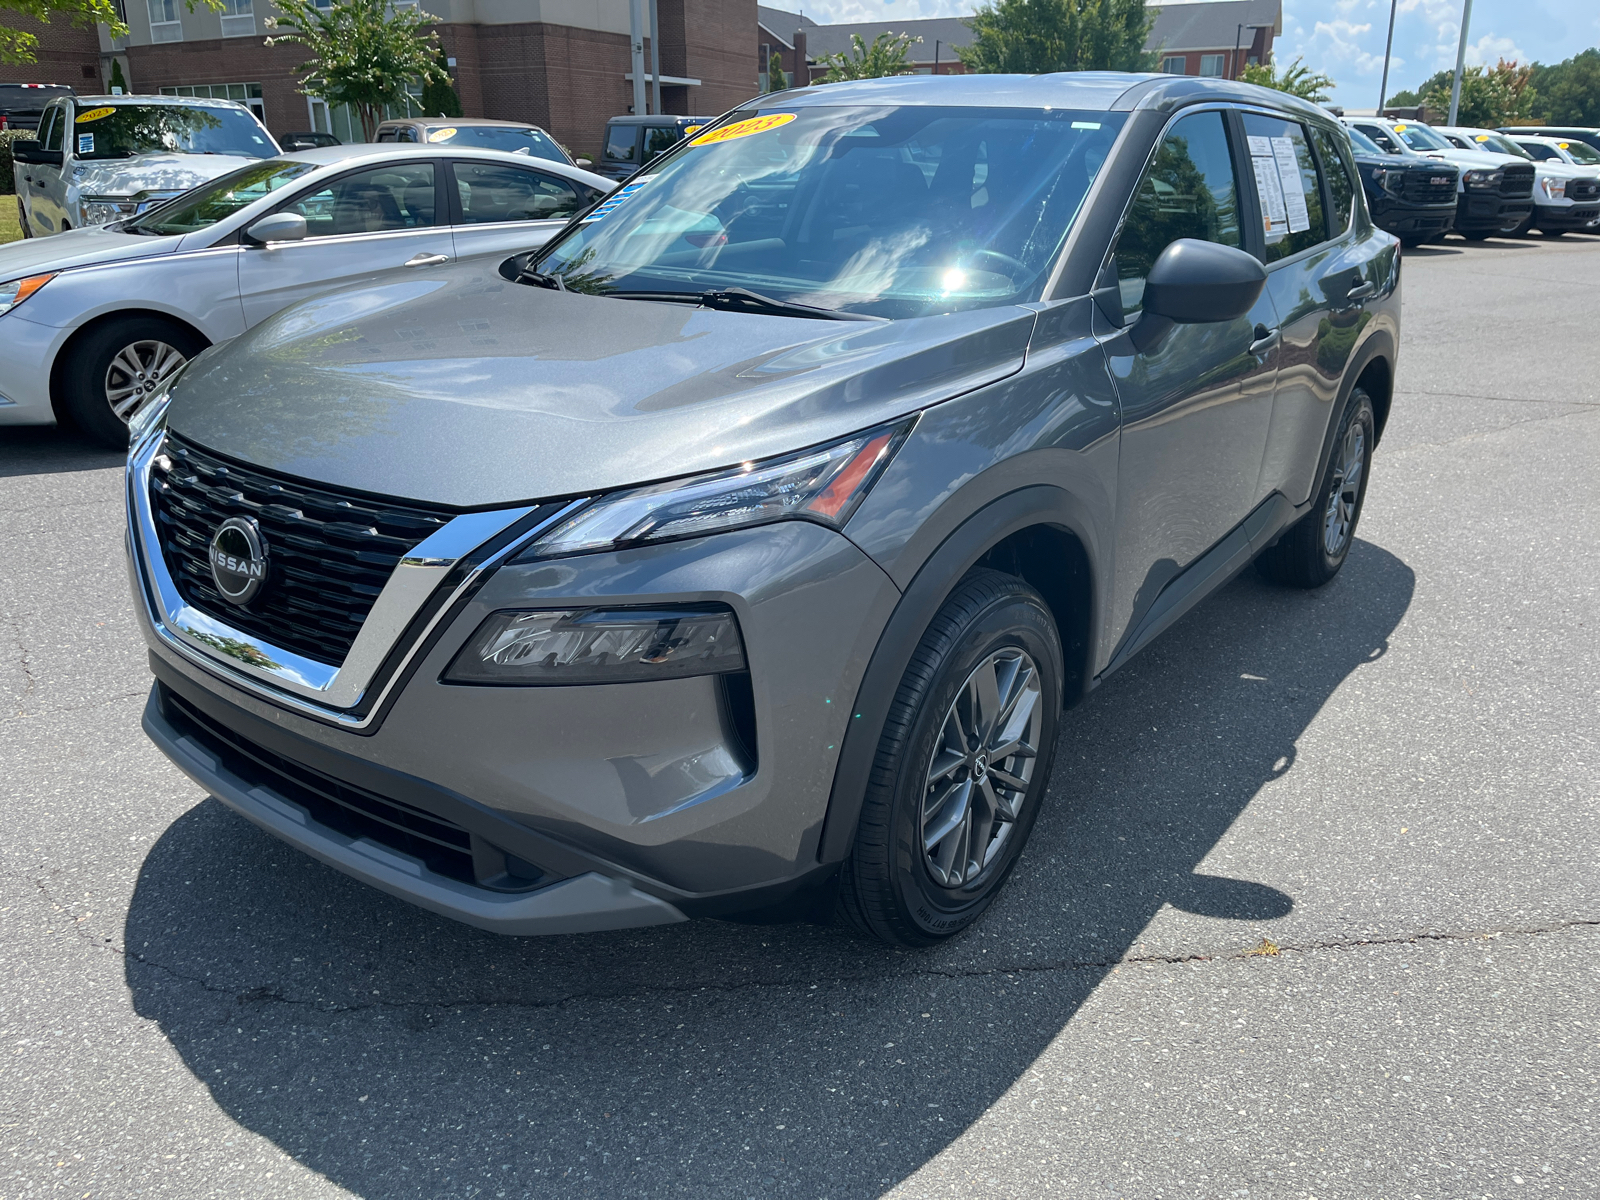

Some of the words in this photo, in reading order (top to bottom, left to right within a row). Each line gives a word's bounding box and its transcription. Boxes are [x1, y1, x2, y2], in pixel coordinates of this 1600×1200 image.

[82, 108, 109, 121] 2023
[701, 116, 781, 143] 2023
[209, 545, 262, 576] NISSAN
[916, 905, 934, 924] 104H
[932, 918, 948, 928] R17
